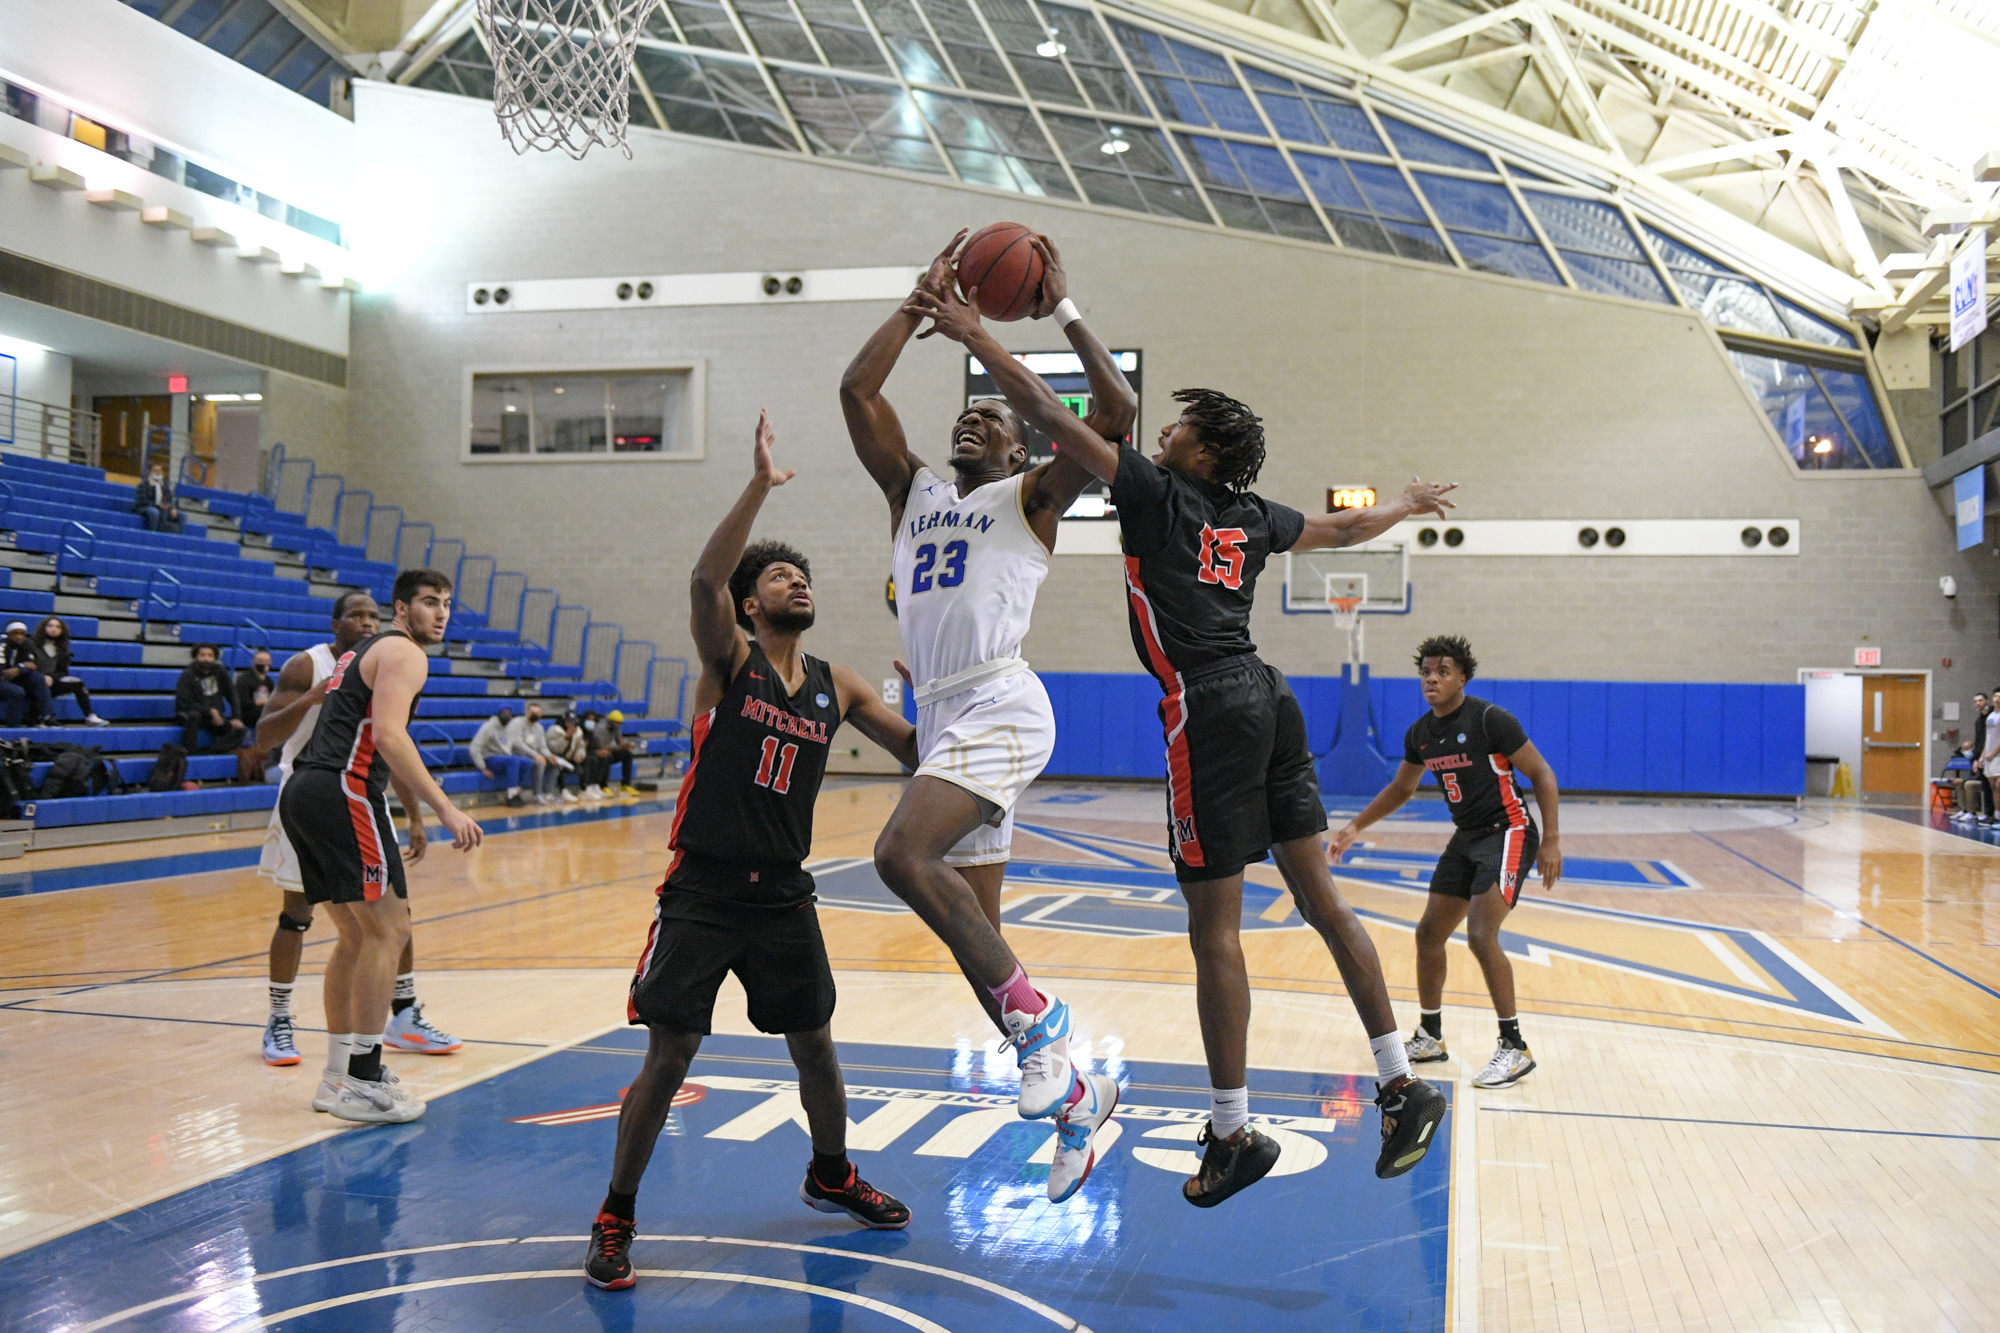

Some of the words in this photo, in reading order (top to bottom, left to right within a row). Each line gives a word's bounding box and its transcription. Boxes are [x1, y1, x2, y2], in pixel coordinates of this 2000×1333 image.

[910, 510, 995, 539] LEHMAN
[911, 538, 970, 596] 23
[1198, 520, 1248, 590] 15
[1858, 650, 1878, 665] EXIT
[741, 694, 828, 744] MITCHELL
[754, 735, 799, 795] 11
[1442, 772, 1463, 803] 5
[1176, 815, 1196, 844] M
[365, 864, 381, 883] M
[1505, 871, 1517, 890] M
